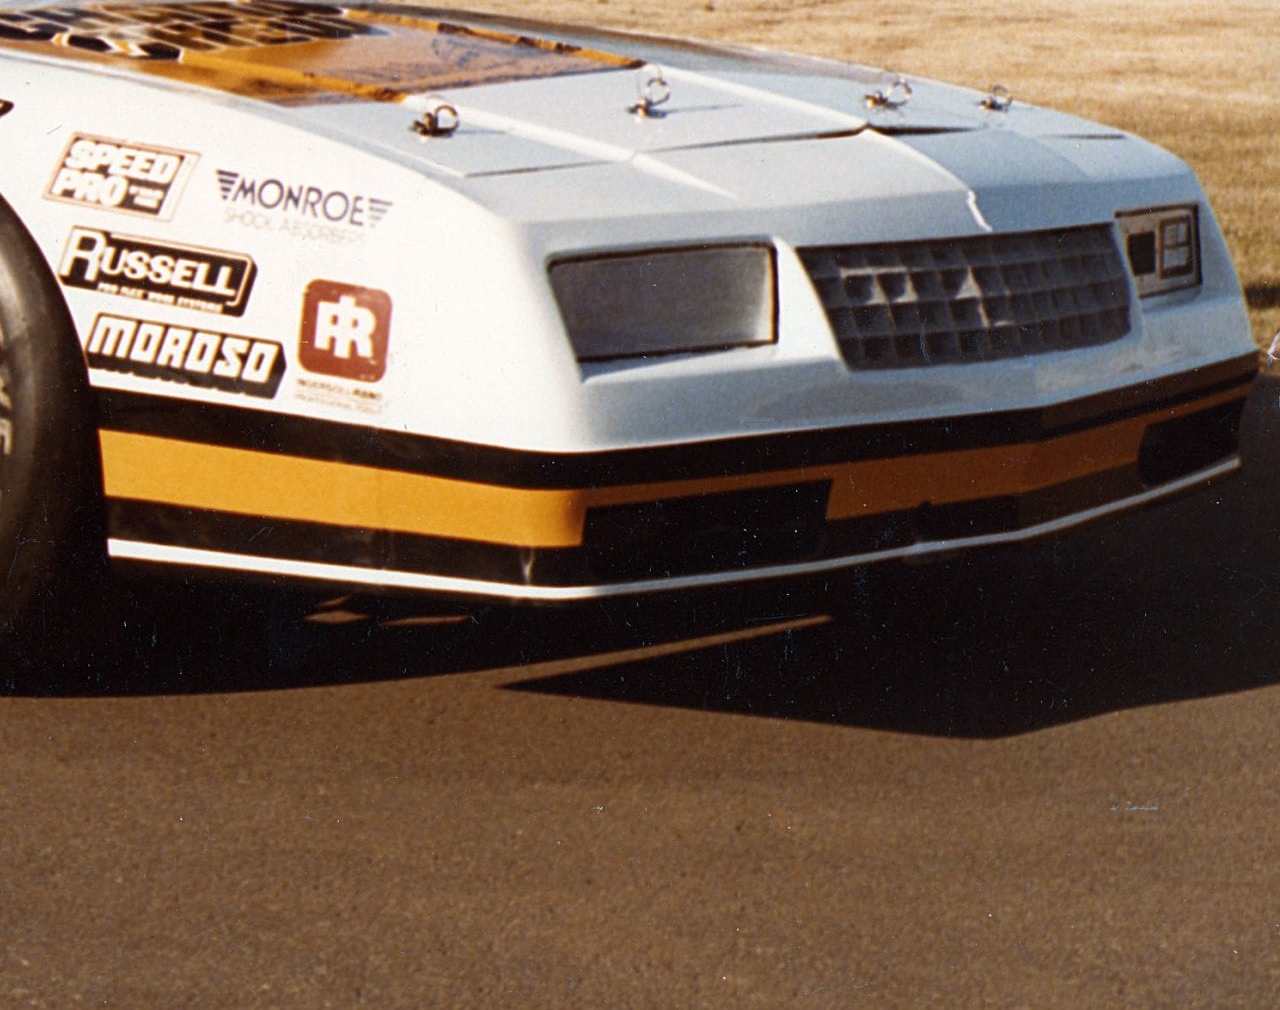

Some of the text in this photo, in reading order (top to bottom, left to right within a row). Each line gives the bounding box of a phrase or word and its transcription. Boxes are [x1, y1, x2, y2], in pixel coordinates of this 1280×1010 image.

[64, 139, 182, 185] SPEED
[51, 168, 129, 207] PRO
[231, 178, 364, 227] MONROE
[59, 227, 236, 296] RUSSELL
[87, 316, 279, 384] MOROSO
